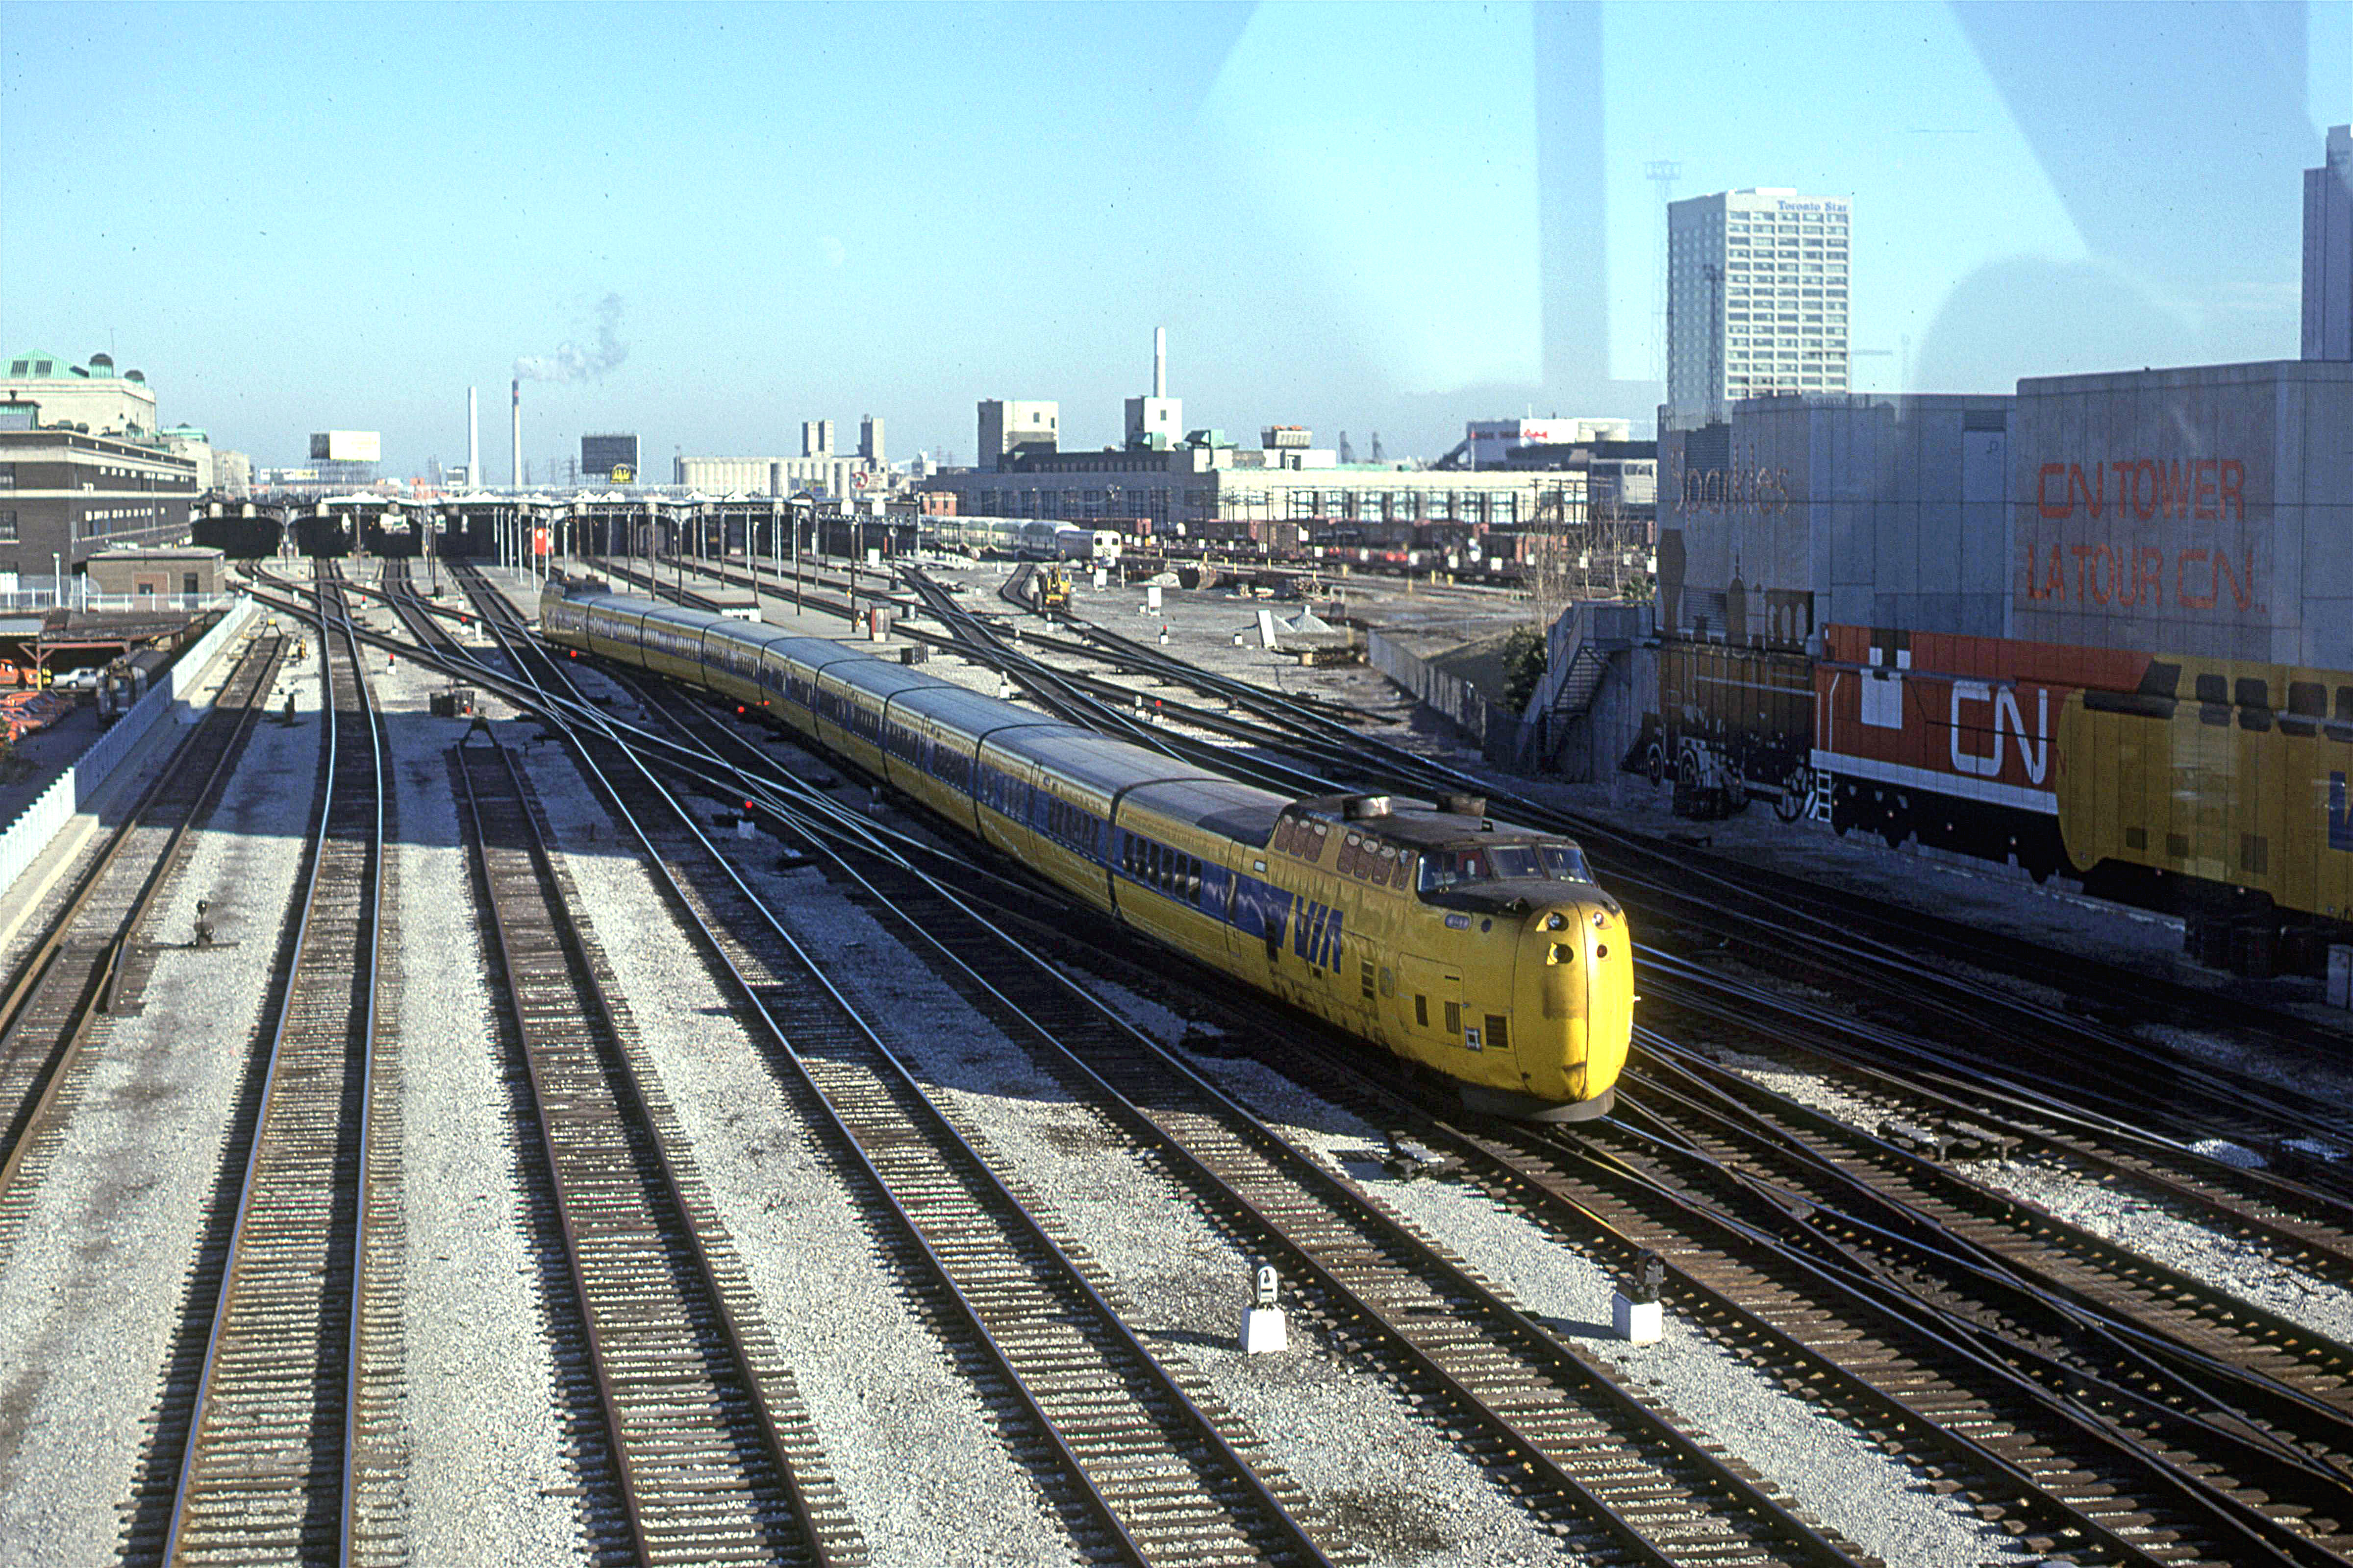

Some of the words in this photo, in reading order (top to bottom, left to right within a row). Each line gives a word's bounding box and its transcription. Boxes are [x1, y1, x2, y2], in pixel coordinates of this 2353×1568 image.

[1777, 200, 1821, 211] Toronto
[1825, 201, 1848, 212] Star
[1670, 441, 1789, 533] Sparkles
[2039, 461, 2103, 519] CN
[2112, 459, 2245, 521] TOWER
[2028, 543, 2066, 601] LA
[2071, 543, 2163, 608] TOUR
[2177, 549, 2253, 612] CN
[1951, 679, 2048, 785] CN
[1294, 894, 1344, 975] VIA
